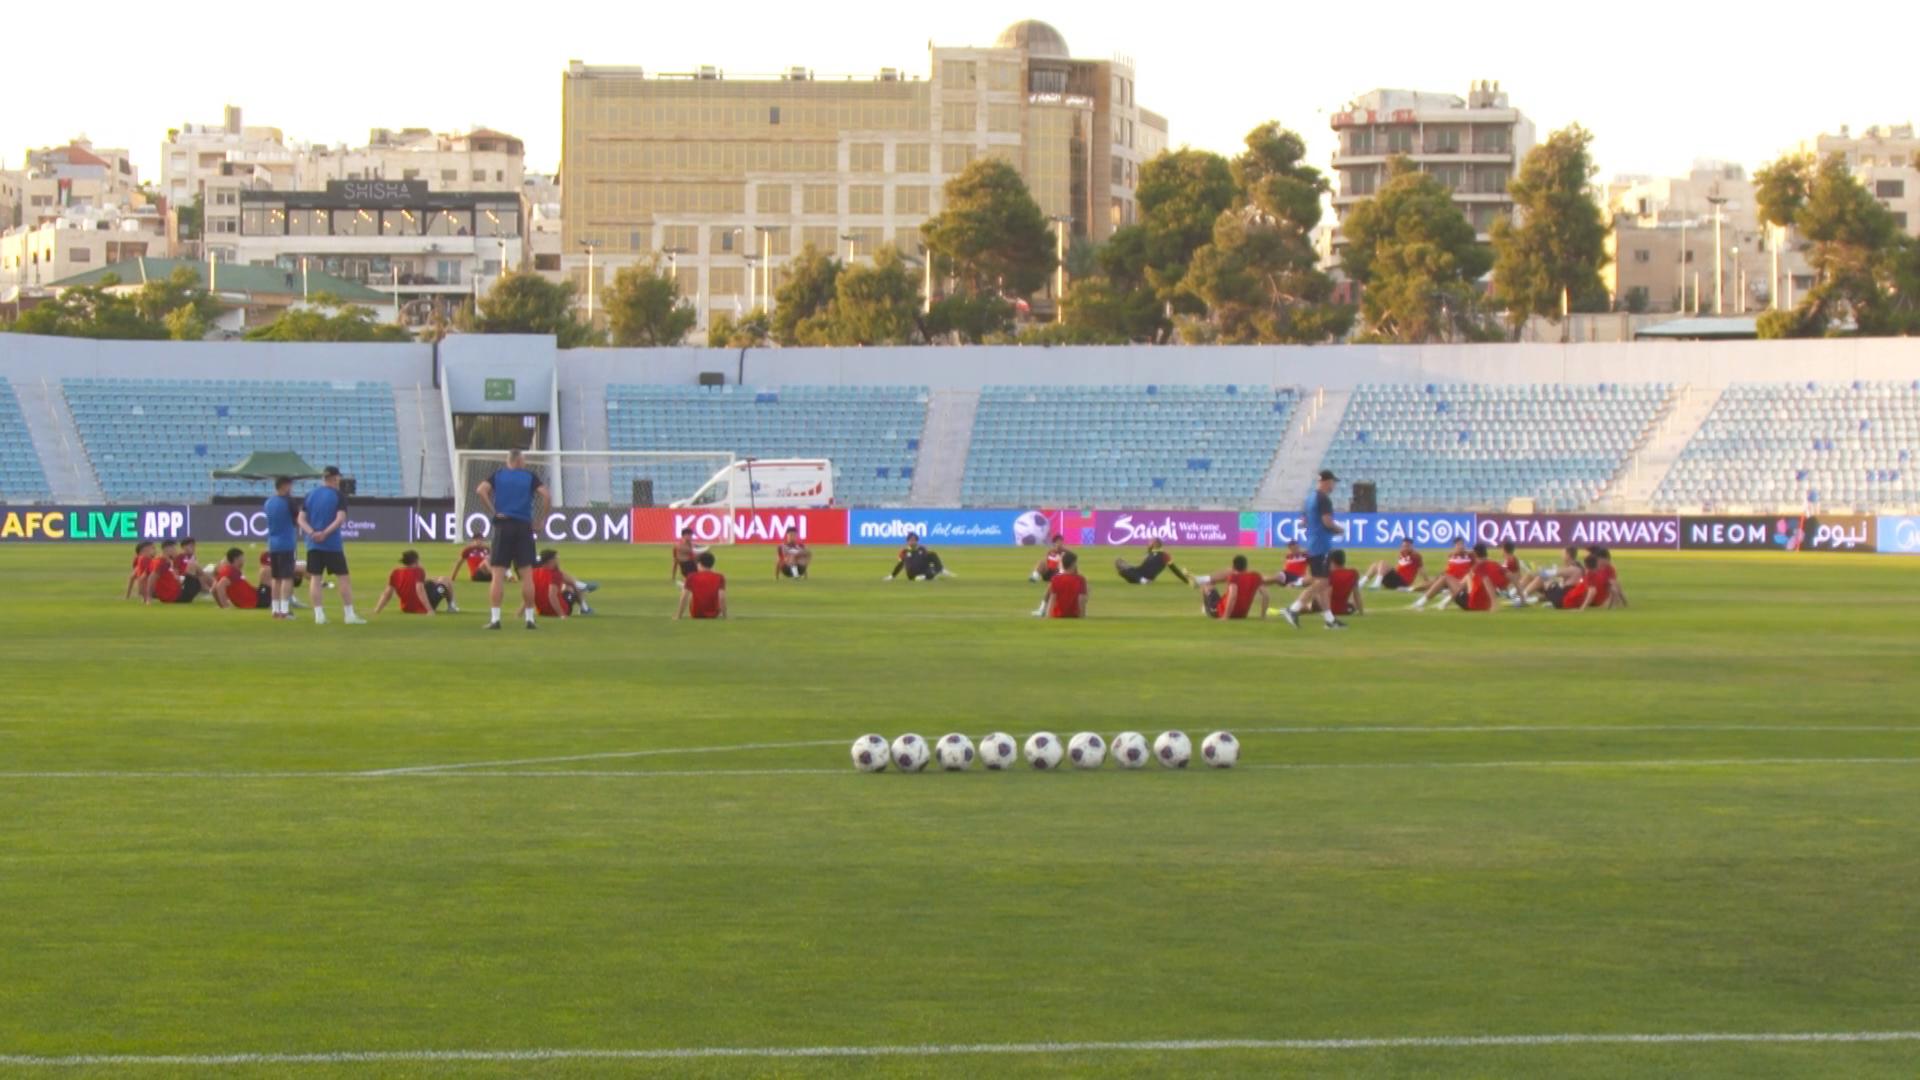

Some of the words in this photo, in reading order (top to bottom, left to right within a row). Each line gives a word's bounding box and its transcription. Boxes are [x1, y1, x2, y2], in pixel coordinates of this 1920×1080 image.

[343, 182, 412, 200] SHISHA
[1, 511, 65, 538] AFC
[69, 511, 138, 538] LIVE
[143, 511, 184, 538] APP
[674, 513, 807, 540] KONAMI
[860, 519, 927, 538] molten
[1107, 514, 1178, 544] Saudi
[1179, 521, 1220, 531] Welcome
[1186, 532, 1196, 540] to
[1198, 530, 1227, 541] Arabia
[1375, 519, 1471, 543] SAISON
[1478, 519, 1562, 546] QATAR
[1571, 520, 1677, 543] AIRWAYS
[1691, 523, 1767, 543] NEOM
[1812, 520, 1867, 548] نيوم
